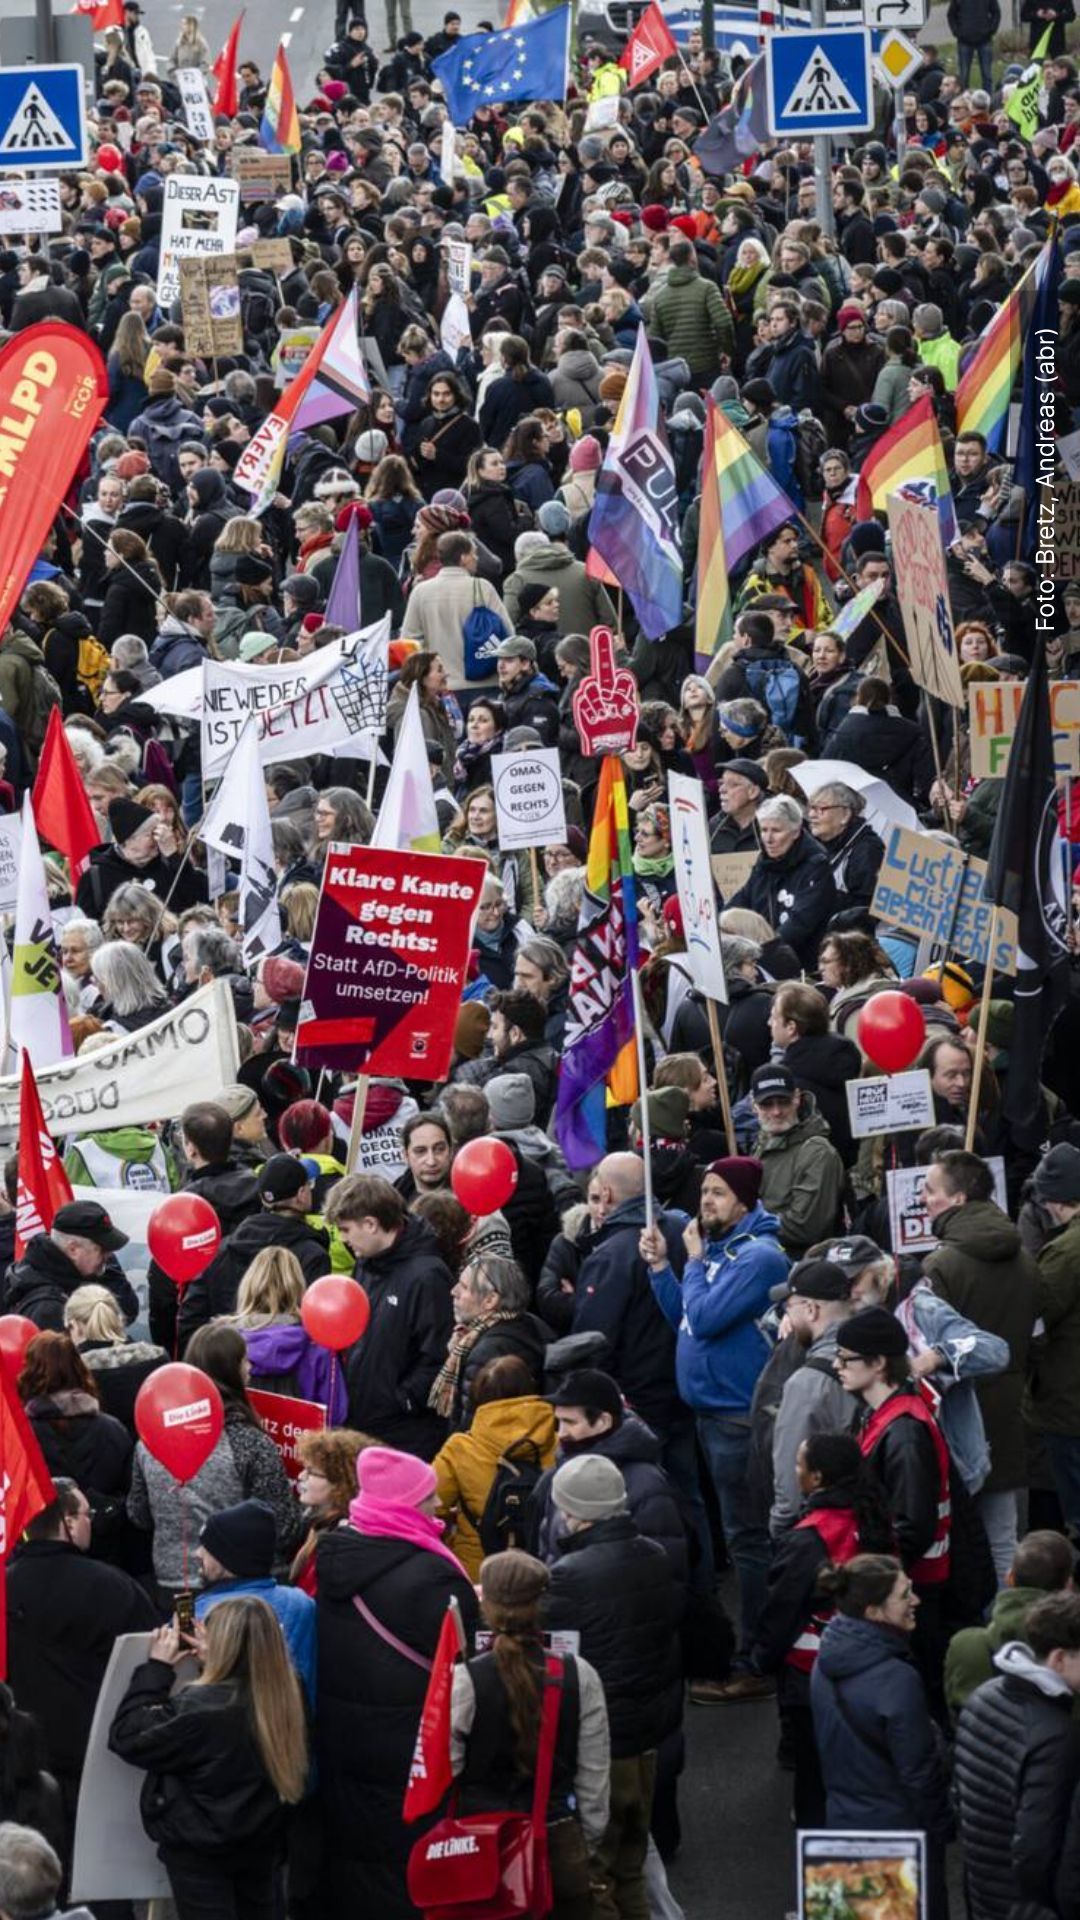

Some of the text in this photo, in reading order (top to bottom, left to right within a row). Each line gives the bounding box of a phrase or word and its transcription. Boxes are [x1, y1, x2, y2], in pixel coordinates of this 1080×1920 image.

[203, 183, 237, 204] AST
[170, 235, 224, 252] HAT MEHR
[69, 375, 96, 420] ICOR
[0, 350, 57, 478] MLPD
[204, 677, 307, 712] NIE WIEDER
[207, 720, 242, 745] IST
[255, 684, 330, 742] JETZT
[510, 765, 542, 777] OMAS
[510, 782, 546, 795] GEGEN
[510, 799, 550, 812] RECHTS
[329, 867, 474, 900] Klare Kante
[359, 900, 433, 925] gegen
[345, 925, 438, 952] Rechts:
[313, 953, 459, 984] Statt AfD-Politik
[336, 982, 430, 1005] umsetzen!
[362, 1126, 402, 1140] OMAS
[360, 1138, 400, 1154] GEGE
[362, 1151, 402, 1168] RECH
